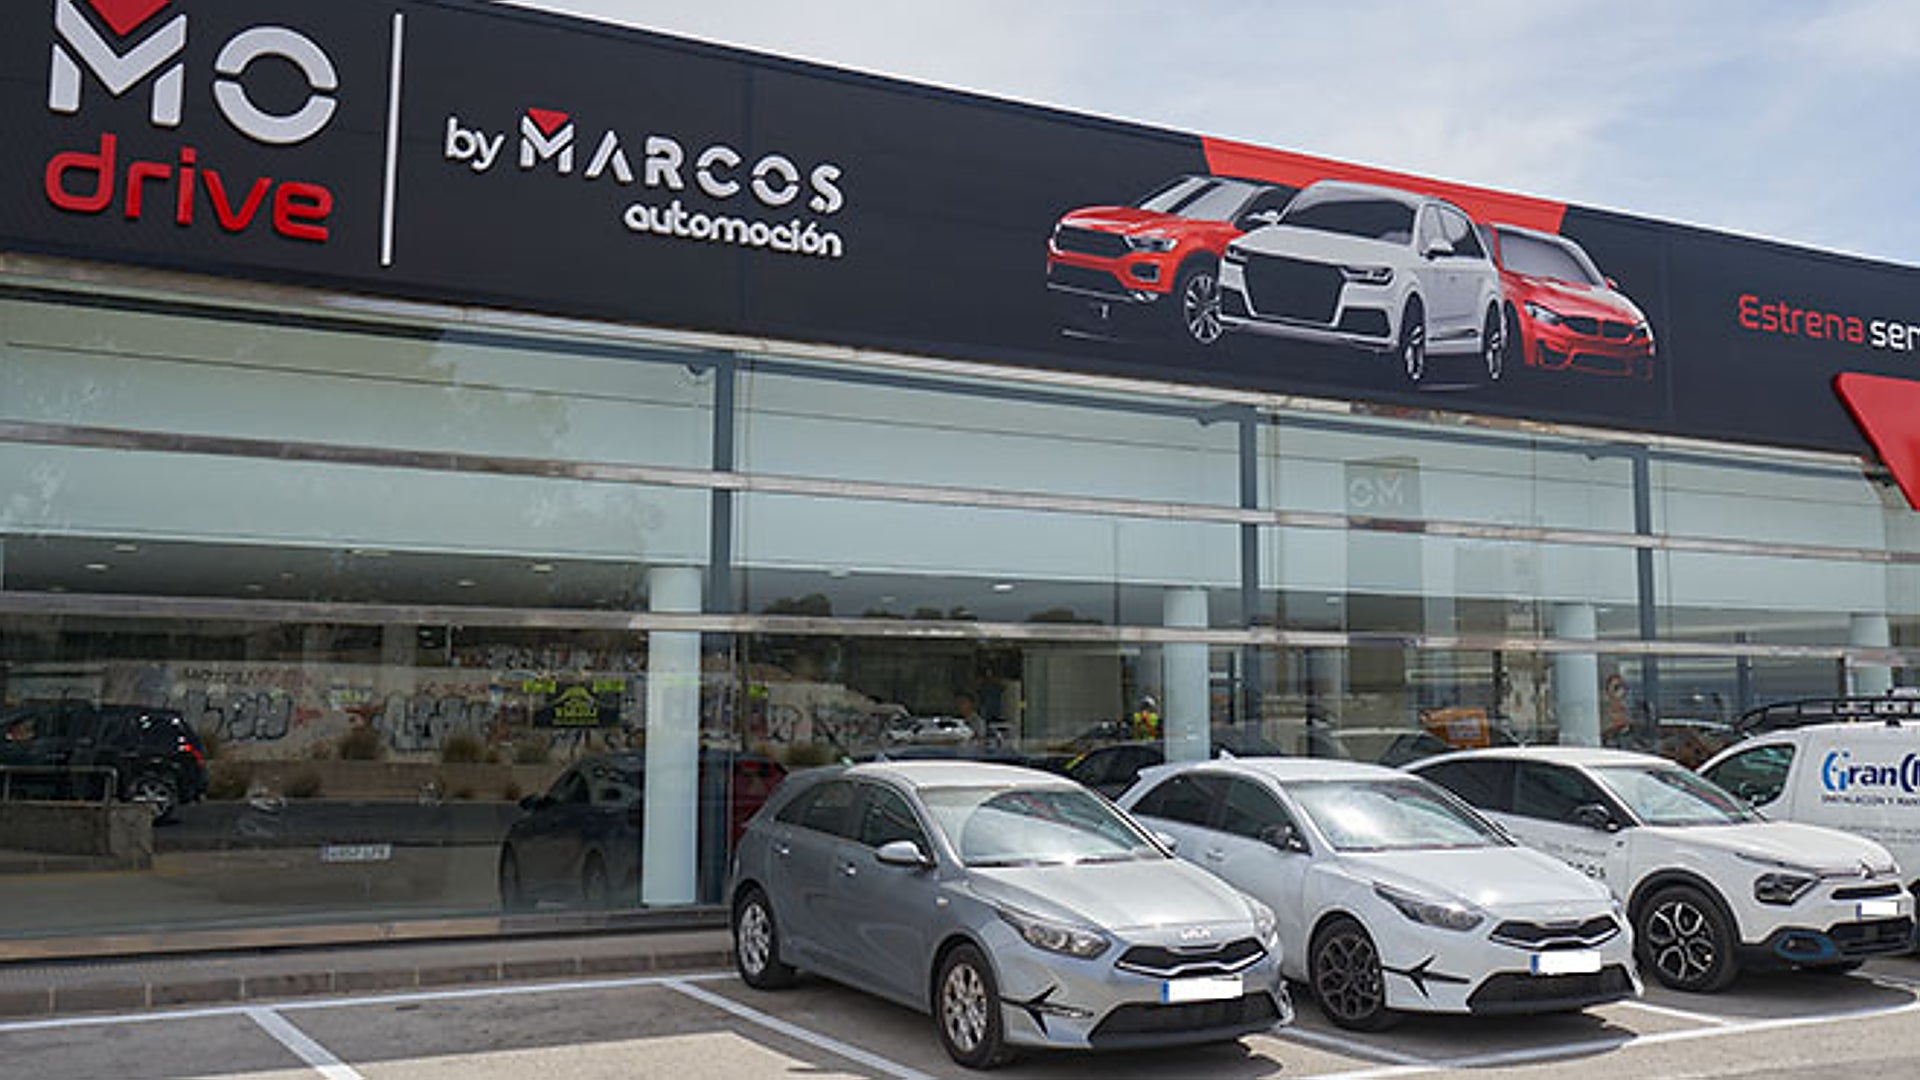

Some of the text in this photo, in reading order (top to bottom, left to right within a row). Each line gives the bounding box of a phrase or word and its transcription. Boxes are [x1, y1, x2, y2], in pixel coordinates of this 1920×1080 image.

[49, 0, 339, 145] MO
[45, 133, 334, 242] drive
[445, 108, 844, 213] by MARCOS
[624, 200, 843, 257] automoción
[1738, 293, 1865, 344] Estrena
